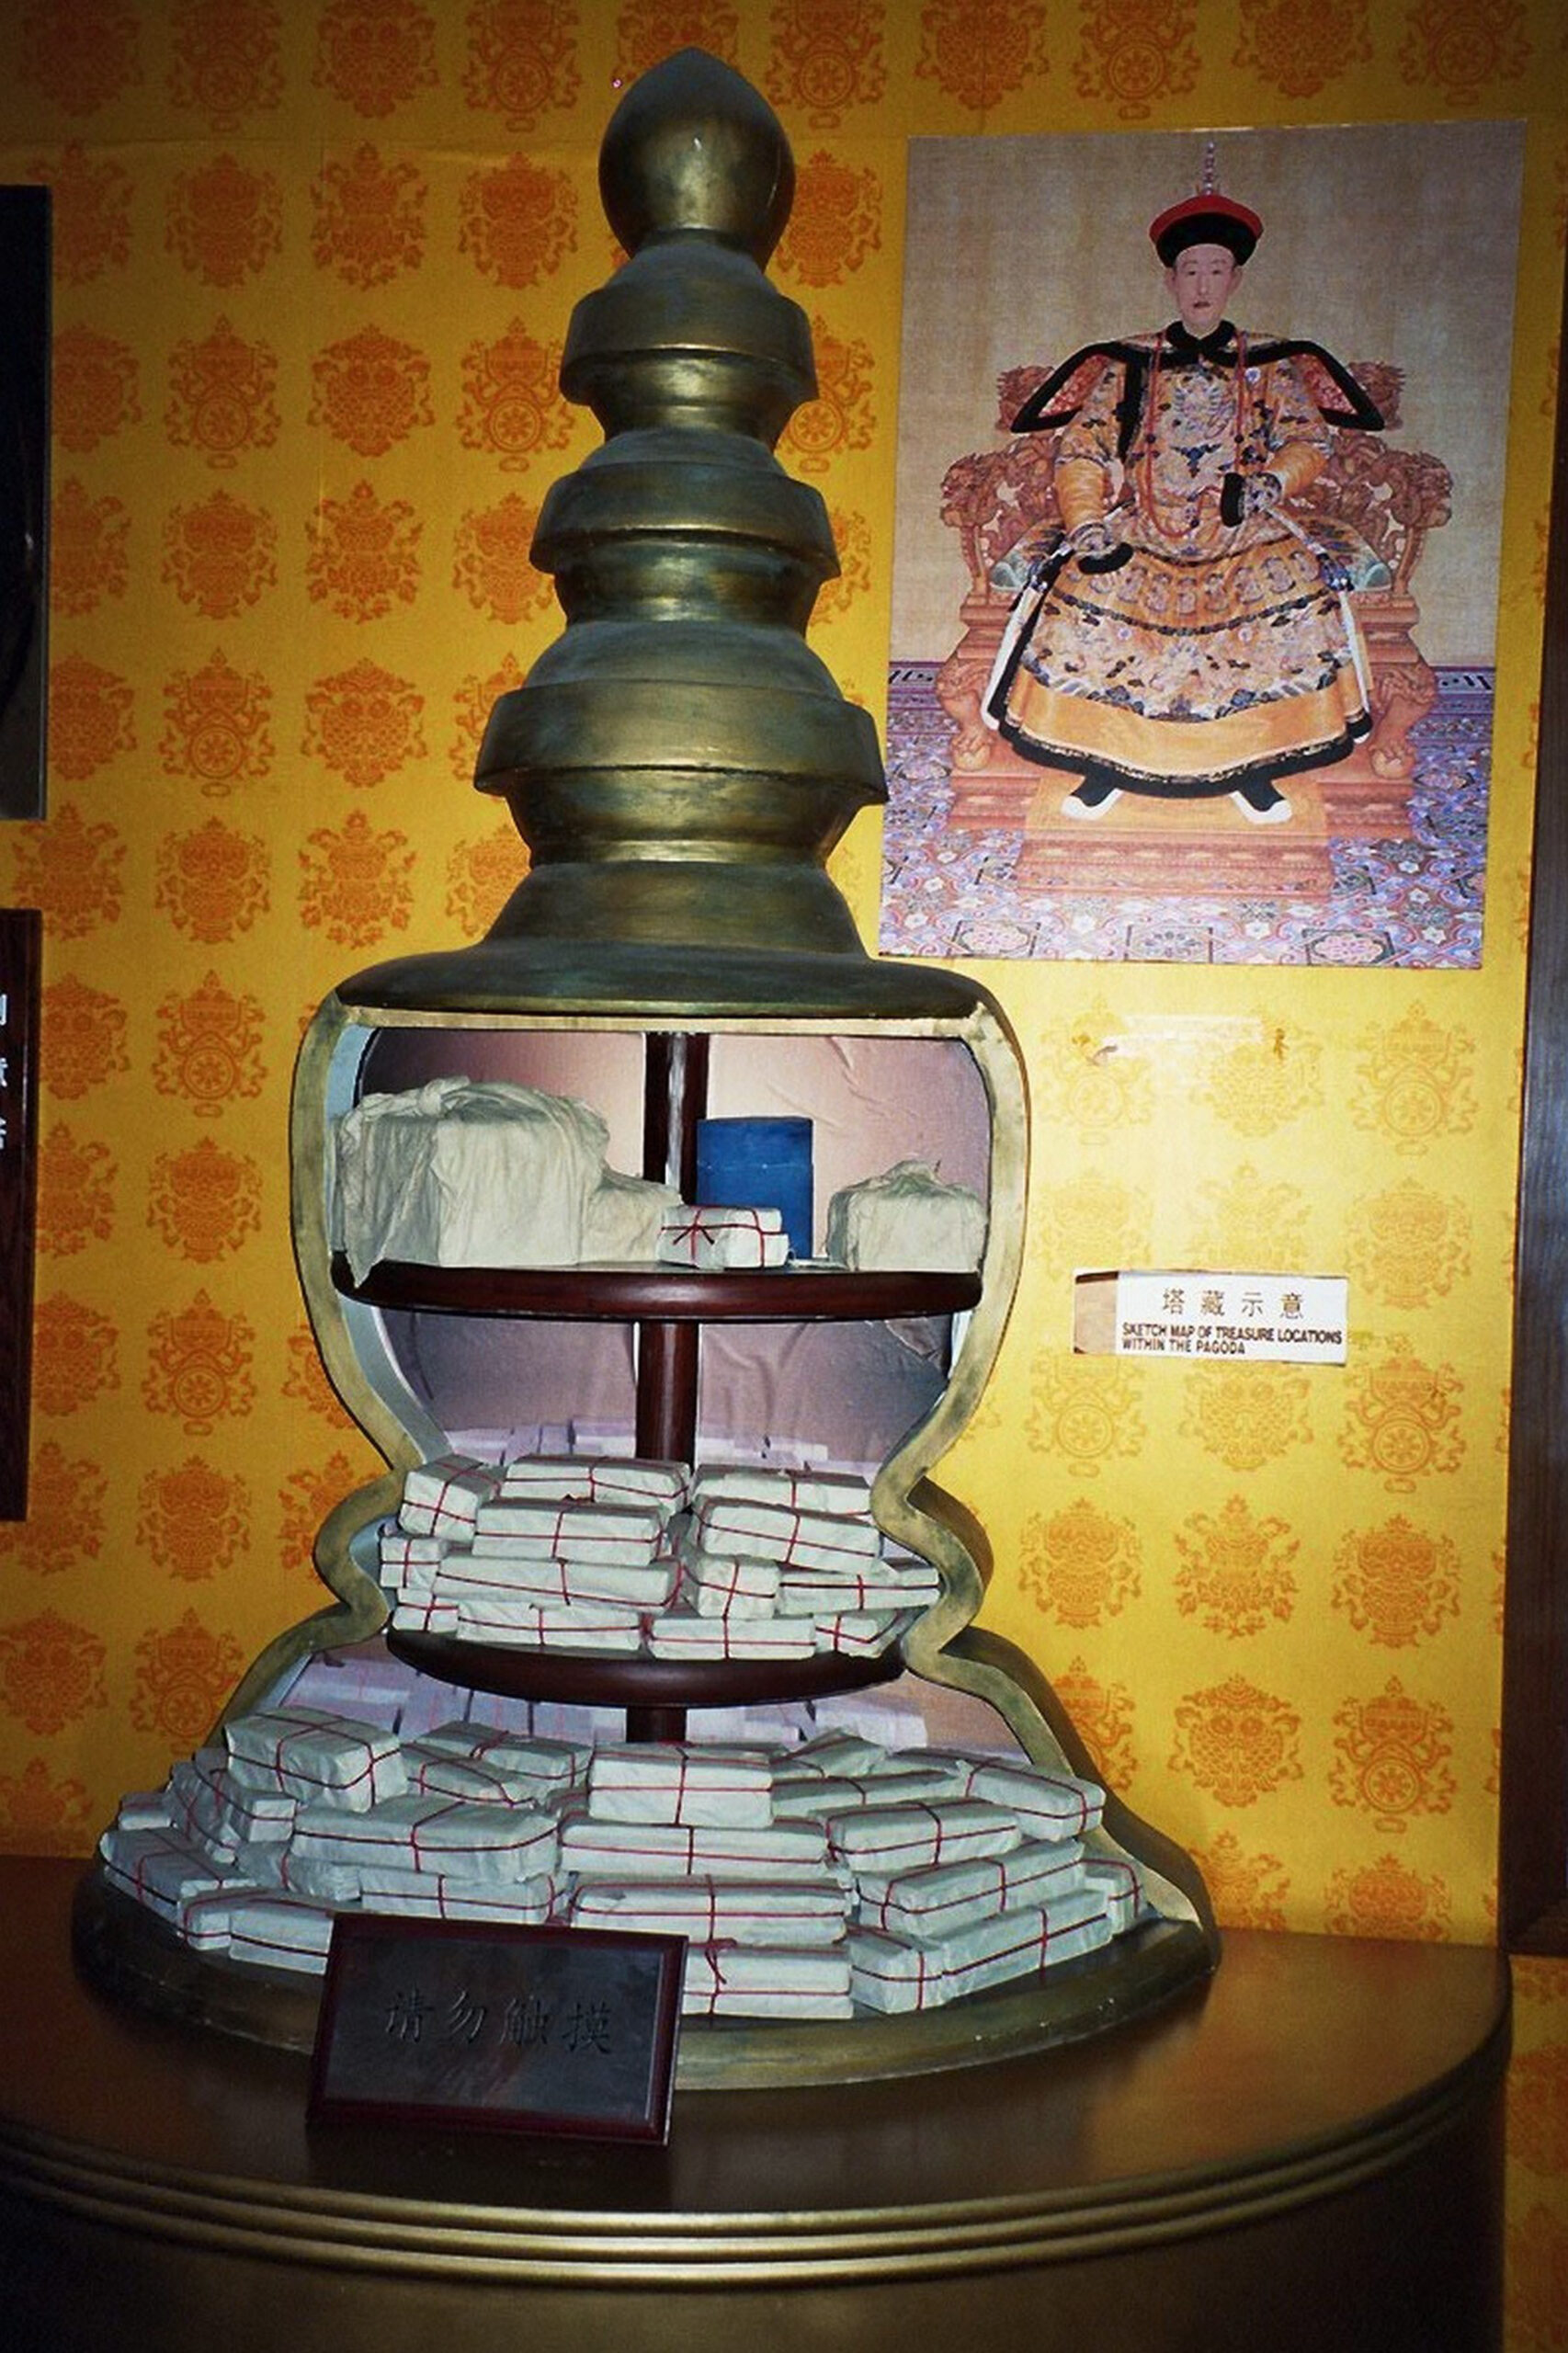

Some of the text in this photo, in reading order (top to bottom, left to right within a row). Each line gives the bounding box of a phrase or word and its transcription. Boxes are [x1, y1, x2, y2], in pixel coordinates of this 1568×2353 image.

[1162, 1288, 1304, 1319] 塔藏示意
[1122, 1322, 1342, 1344] SKETCH MAP OF TREASURE LOCATIONS
[1122, 1337, 1245, 1355] WITHIN THE PAGODA
[384, 1984, 612, 2055] 请勿触摸
